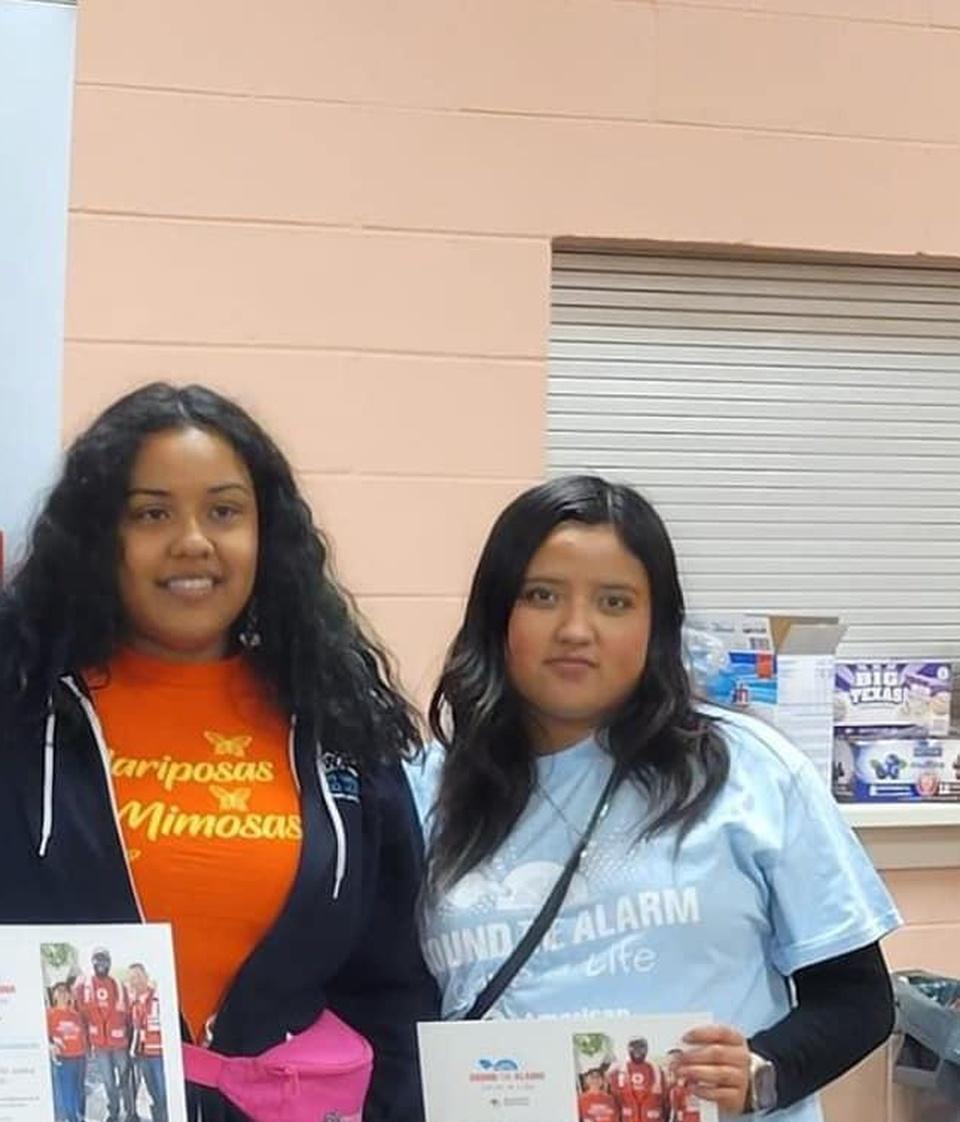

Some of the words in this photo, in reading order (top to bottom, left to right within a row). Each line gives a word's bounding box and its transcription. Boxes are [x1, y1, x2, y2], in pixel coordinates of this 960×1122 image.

[849, 686, 904, 705] TEXAS
[855, 671, 898, 687] BIG
[109, 750, 275, 791] ariposas
[118, 799, 303, 841] Mimosas
[572, 886, 700, 944] ALARM
